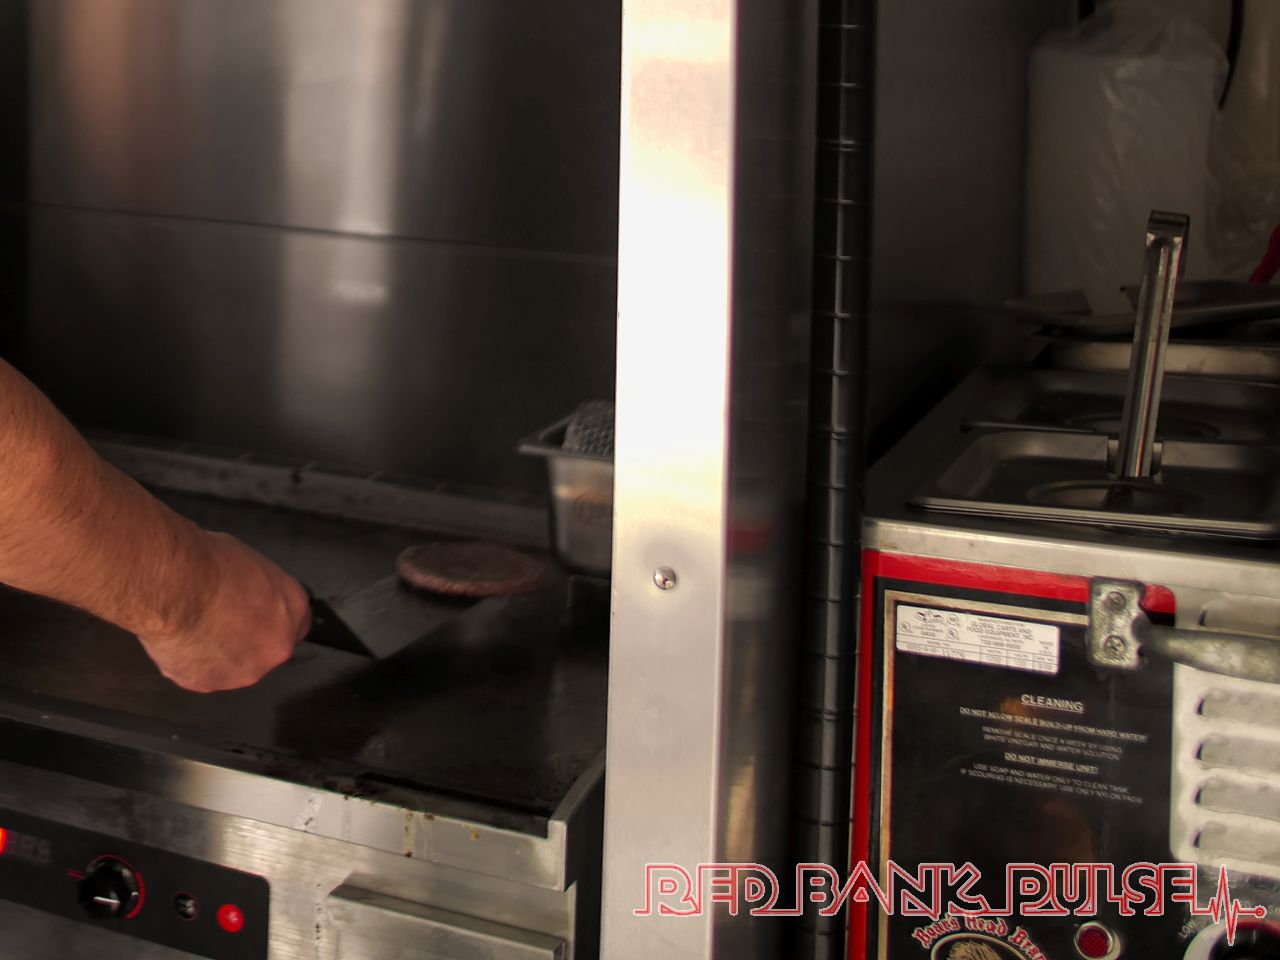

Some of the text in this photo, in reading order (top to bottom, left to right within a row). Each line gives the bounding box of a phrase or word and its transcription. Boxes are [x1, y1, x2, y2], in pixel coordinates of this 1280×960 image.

[1021, 694, 1084, 713] CLEANING
[1004, 752, 1016, 761] DO
[1017, 754, 1035, 764] NOT
